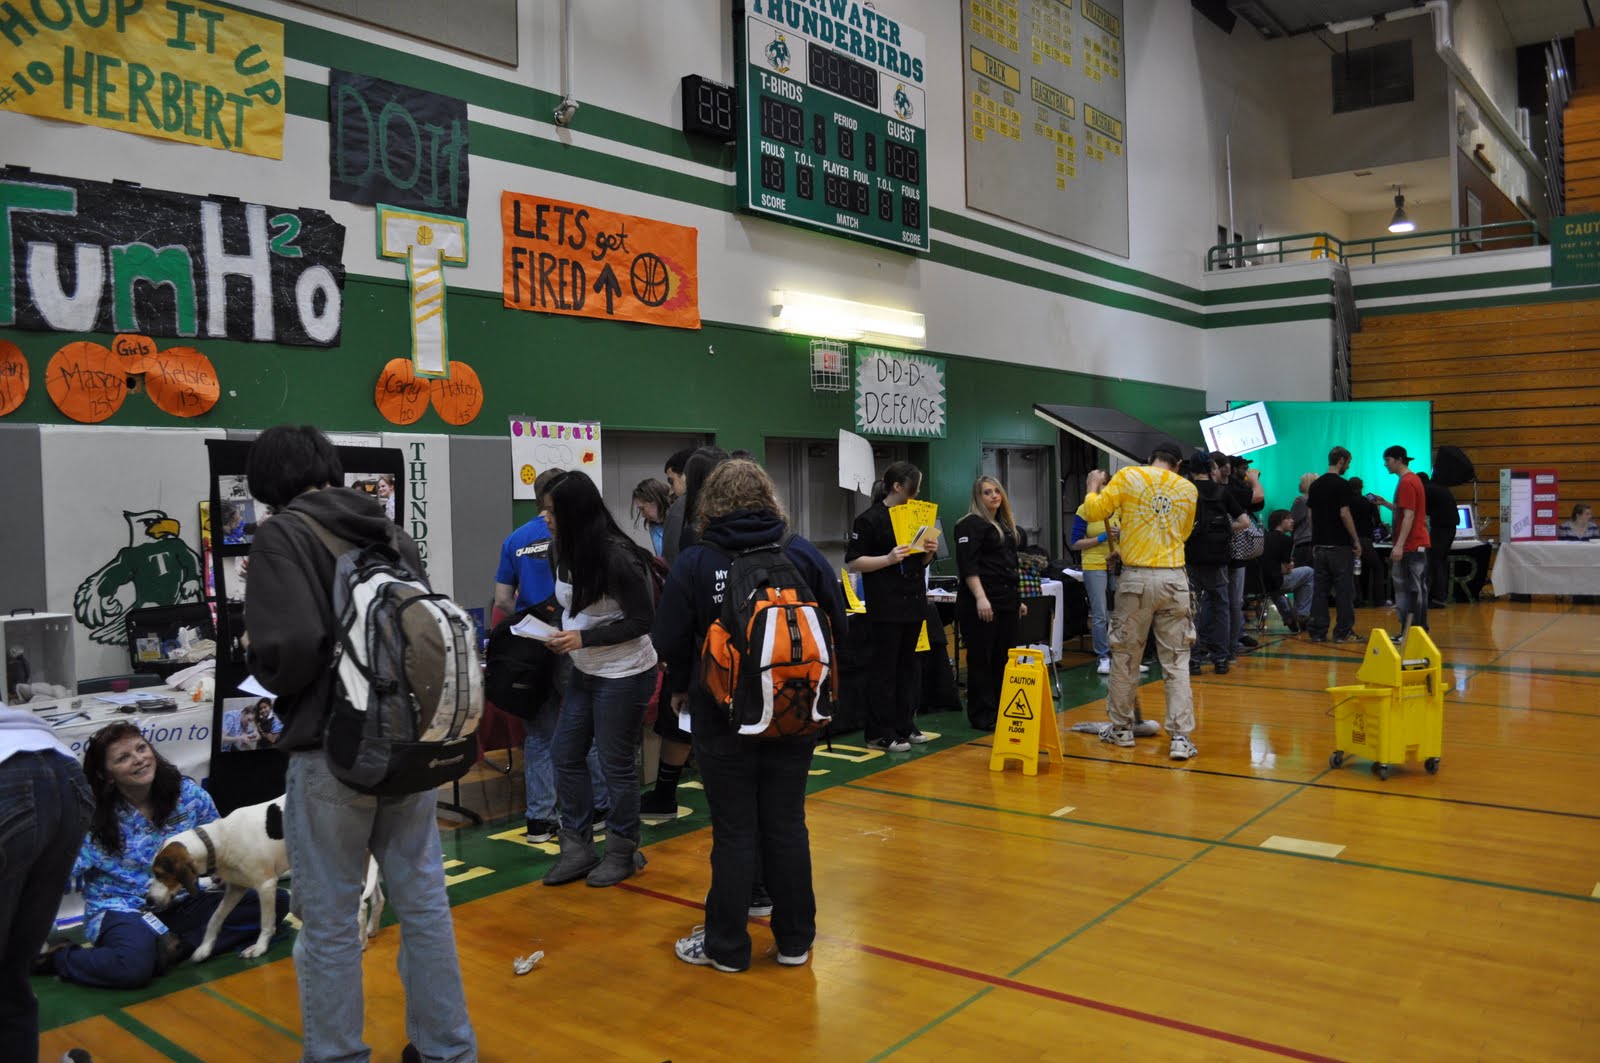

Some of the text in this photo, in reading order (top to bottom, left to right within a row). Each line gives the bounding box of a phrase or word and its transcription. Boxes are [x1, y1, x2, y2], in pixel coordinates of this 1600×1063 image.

[0, 0, 224, 54] HOOP IT
[234, 44, 281, 106] UP
[984, 56, 1006, 82] TRACK
[760, 72, 803, 103] T-BIRDS
[63, 44, 254, 149] HERBERT
[833, 112, 858, 131] PERIOD
[887, 120, 916, 144] GUEST
[760, 141, 785, 159] FOULS
[794, 151, 815, 168] T.O.L.
[823, 160, 870, 185] PLAYER FOUL
[876, 177, 895, 192] T.O.L.
[901, 185, 920, 200] FOULS
[761, 194, 786, 211] SCORE
[836, 213, 859, 229] MATCH
[513, 200, 629, 261] LETS get
[902, 231, 921, 246] SCORE
[511, 246, 586, 311] FIRED
[116, 340, 150, 356] Girls
[386, 373, 421, 403] Carly
[180, 390, 200, 407] 13
[402, 408, 414, 421] 20
[865, 392, 936, 425] DEFENSE
[572, 424, 600, 441] arts
[409, 442, 430, 578] THUNDE
[148, 551, 171, 577] T
[715, 569, 728, 580] MY
[712, 593, 724, 604] YO
[1009, 675, 1036, 686] CAUTION
[188, 724, 209, 741] to
[1008, 726, 1025, 734] FLOOR
